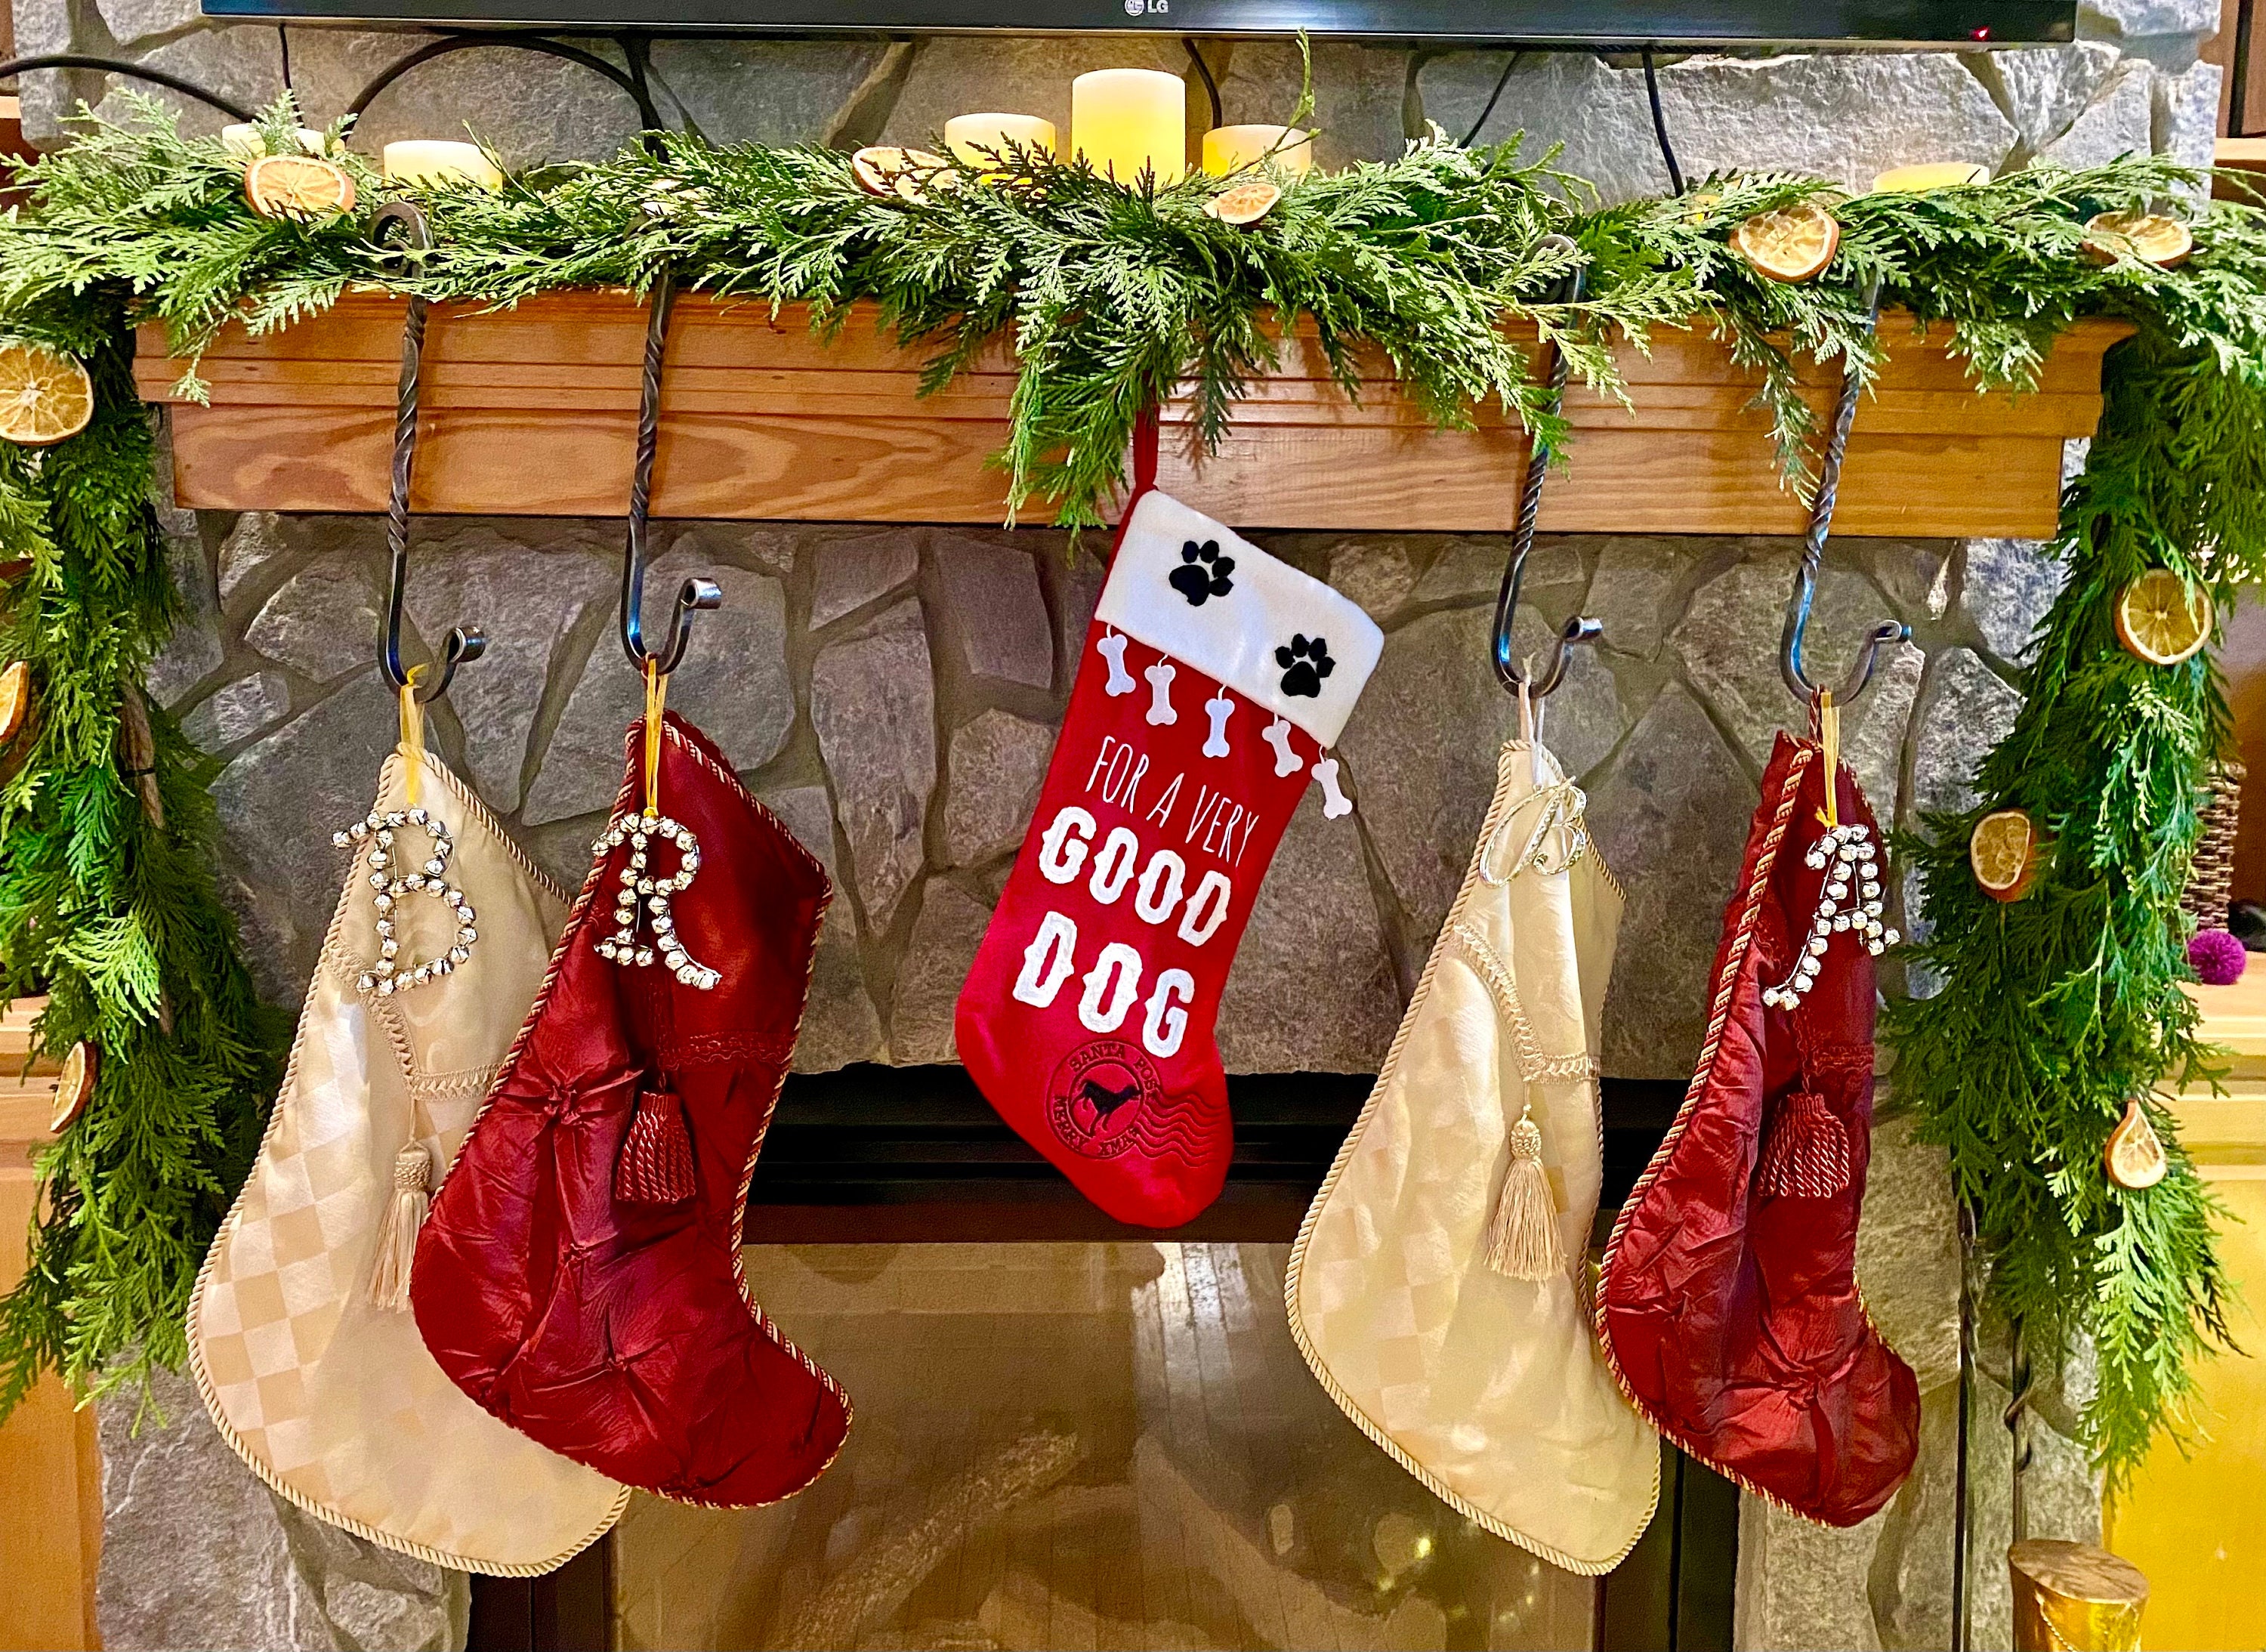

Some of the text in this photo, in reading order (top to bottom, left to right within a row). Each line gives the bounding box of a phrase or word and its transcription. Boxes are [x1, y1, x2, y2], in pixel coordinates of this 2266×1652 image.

[1147, 0, 1169, 14] LG
[1085, 735, 1260, 868] FOR A VERY
[331, 807, 478, 997] B
[590, 811, 724, 991] R
[1038, 805, 1232, 947] GOOD
[1011, 910, 1196, 1059] DOG
[1054, 1095, 1091, 1151] MERRY
[1069, 1043, 1126, 1073] SANTA
